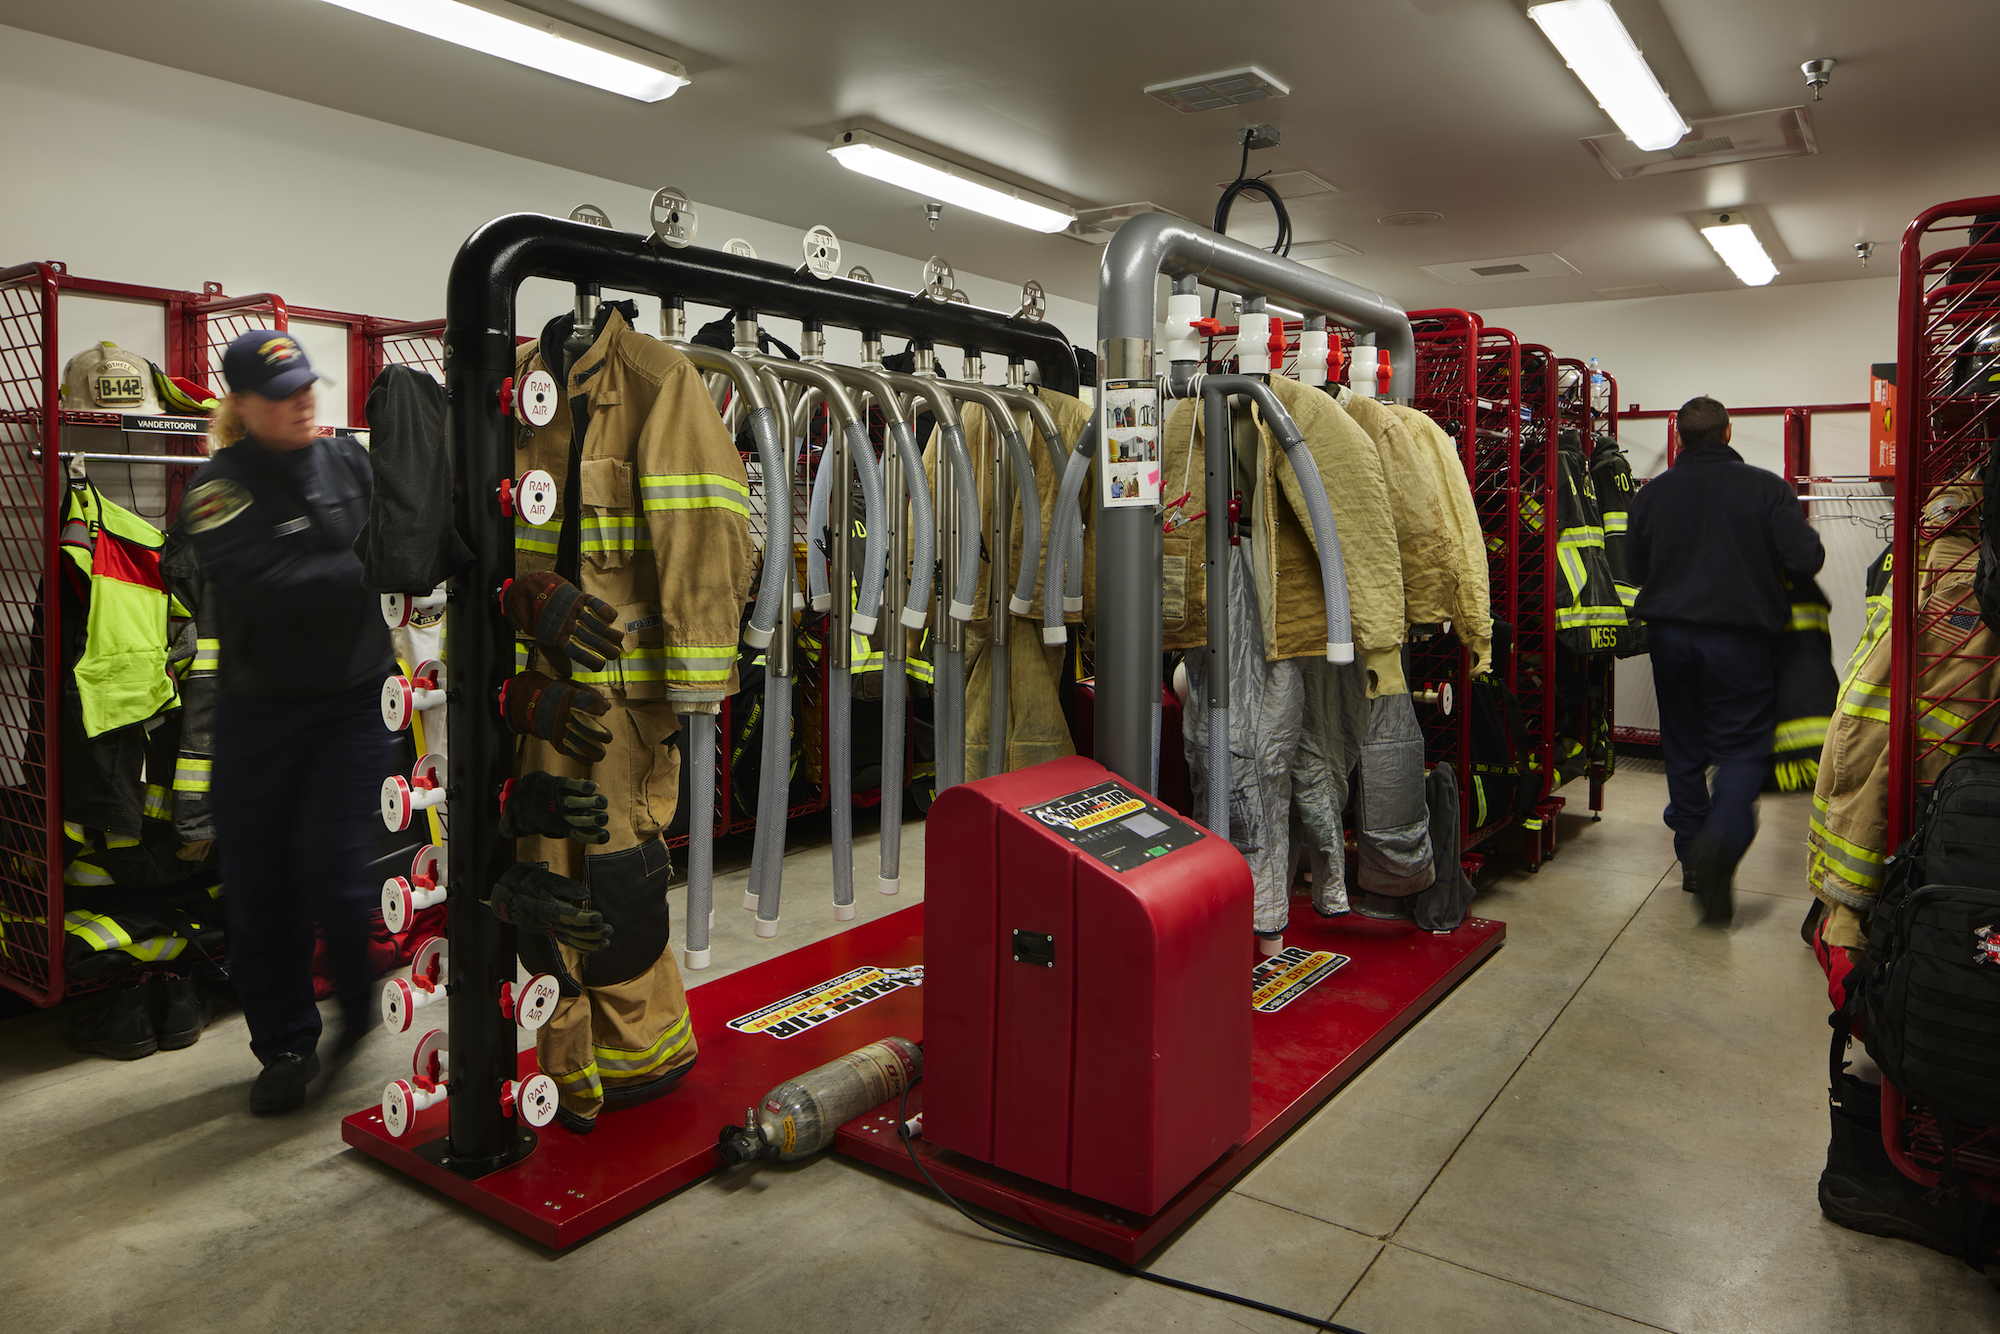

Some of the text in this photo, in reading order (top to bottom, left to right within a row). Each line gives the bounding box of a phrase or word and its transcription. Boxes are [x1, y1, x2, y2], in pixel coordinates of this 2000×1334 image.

[662, 197, 688, 212] RAM
[667, 226, 685, 237] AIR
[813, 234, 833, 247] RAM
[816, 260, 830, 270] AIR
[102, 362, 132, 372] BOTHELL
[101, 379, 140, 396] B-142
[530, 381, 551, 393] RAM
[532, 405, 548, 416] AIR
[137, 419, 197, 431] VANDERTOORN
[529, 480, 550, 493] RAM
[529, 504, 546, 515] AIR
[387, 608, 399, 618] AIR
[1591, 627, 1617, 649] WESS
[386, 686, 400, 700] RAM
[387, 711, 398, 722] AIR
[385, 787, 399, 801] RAM
[1058, 791, 1132, 821] RAM AIR
[386, 811, 397, 823] AIR
[1076, 801, 1140, 828] GEAR DRYER
[386, 888, 400, 900] RAM
[387, 913, 399, 925] AIR
[1253, 955, 1327, 1004] GEAR DRYER
[387, 989, 402, 1003] RAM
[534, 984, 556, 1000] RAM
[753, 973, 879, 1029] GEAR DRYER
[525, 1008, 543, 1021] AIR
[764, 979, 901, 1039] RAM AIR
[386, 1012, 398, 1026] AIR
[903, 1058, 914, 1072] 5.5
[387, 1091, 402, 1105] RAM
[526, 1081, 549, 1104] RAM
[537, 1102, 552, 1120] AIR
[387, 1115, 399, 1129] AIR
